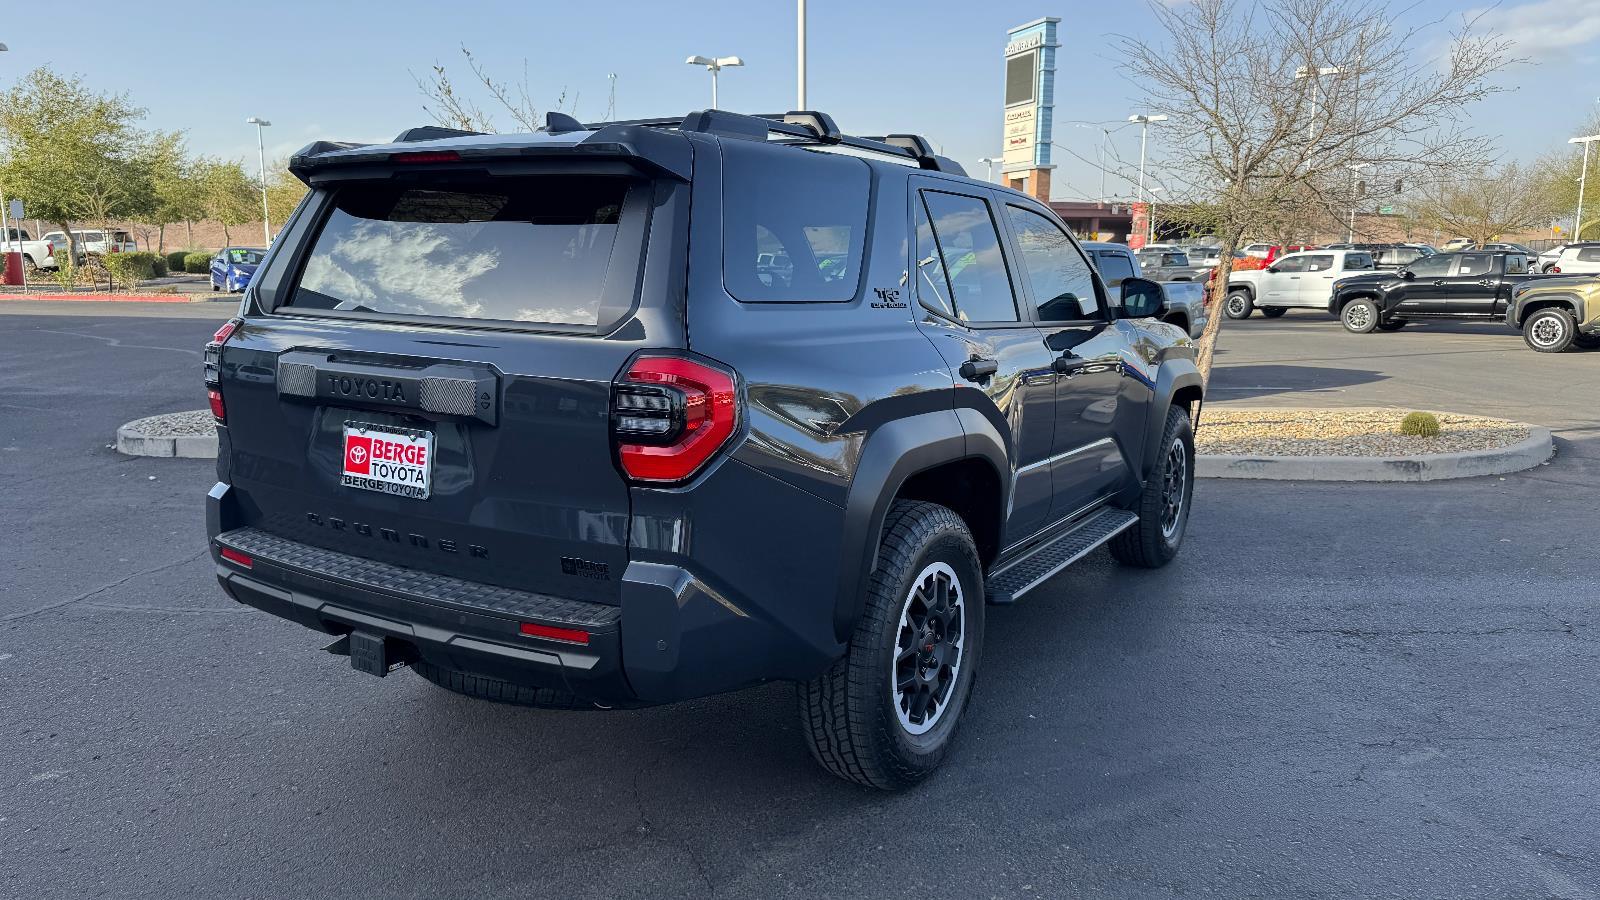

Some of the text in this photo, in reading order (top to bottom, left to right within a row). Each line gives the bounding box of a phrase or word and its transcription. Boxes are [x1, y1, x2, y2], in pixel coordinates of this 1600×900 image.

[328, 375, 406, 402] TOYOTA
[372, 439, 426, 465] BERGE
[371, 462, 425, 484] TOYOTA
[344, 475, 425, 498] BERGE TOYOTA
